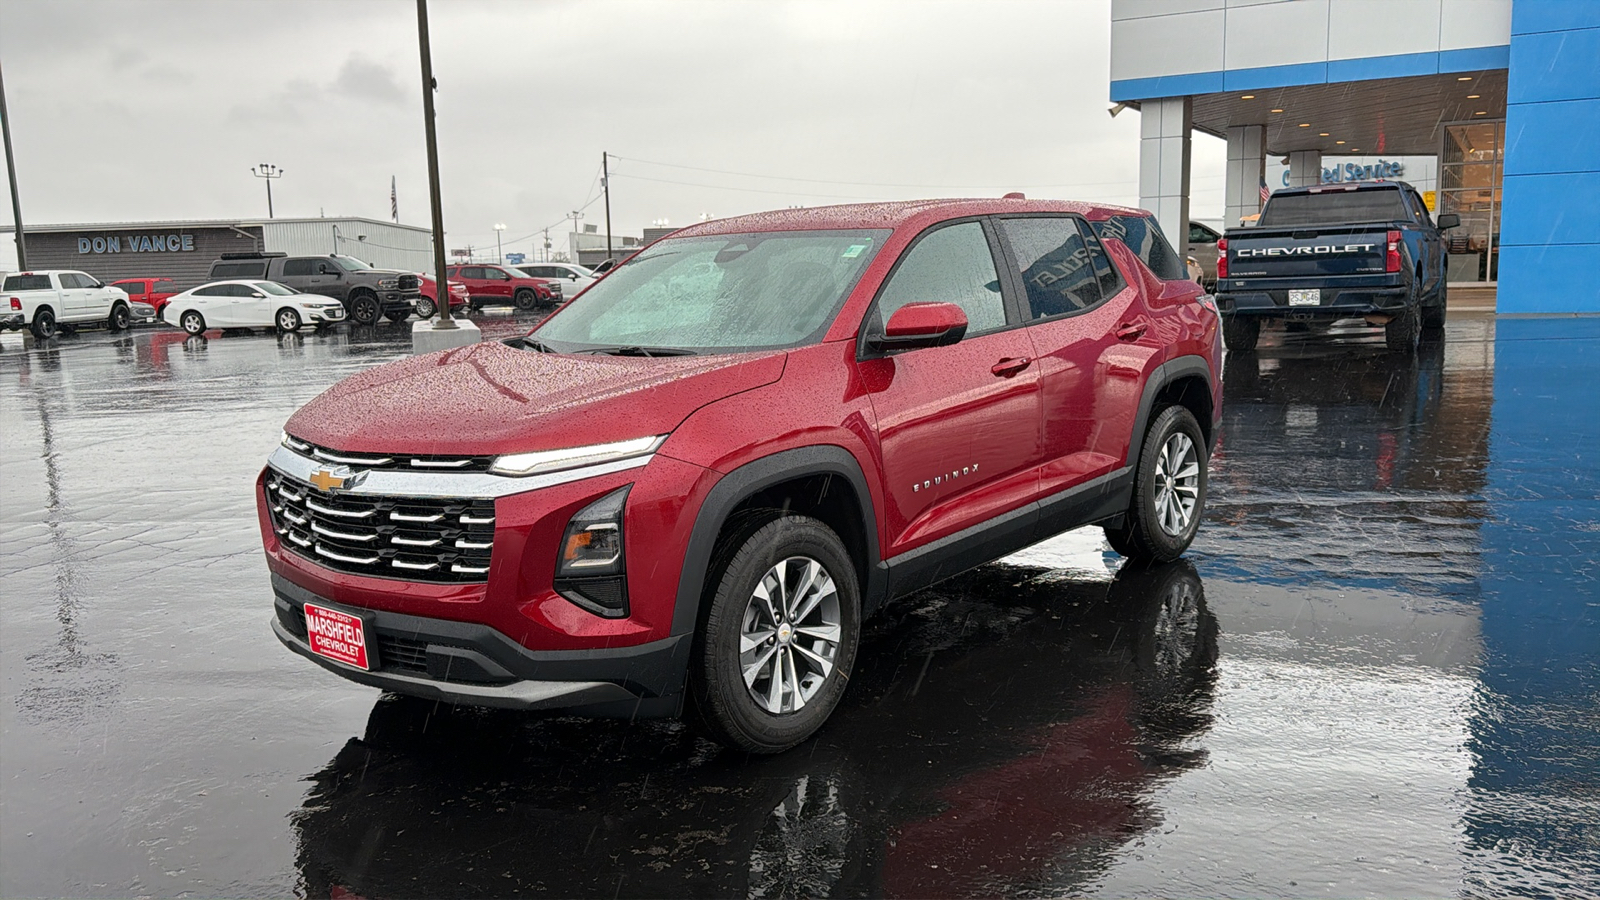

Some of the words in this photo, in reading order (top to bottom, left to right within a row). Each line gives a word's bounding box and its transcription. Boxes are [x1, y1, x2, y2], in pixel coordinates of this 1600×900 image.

[1345, 159, 1401, 181] Service
[77, 237, 120, 254] DON
[128, 234, 195, 253] VANCE
[1237, 244, 1376, 257] CHEVROLET
[912, 463, 979, 493] EQUINOX
[306, 614, 364, 647] MARSHFIELD
[315, 635, 359, 657] CHEVROLET
